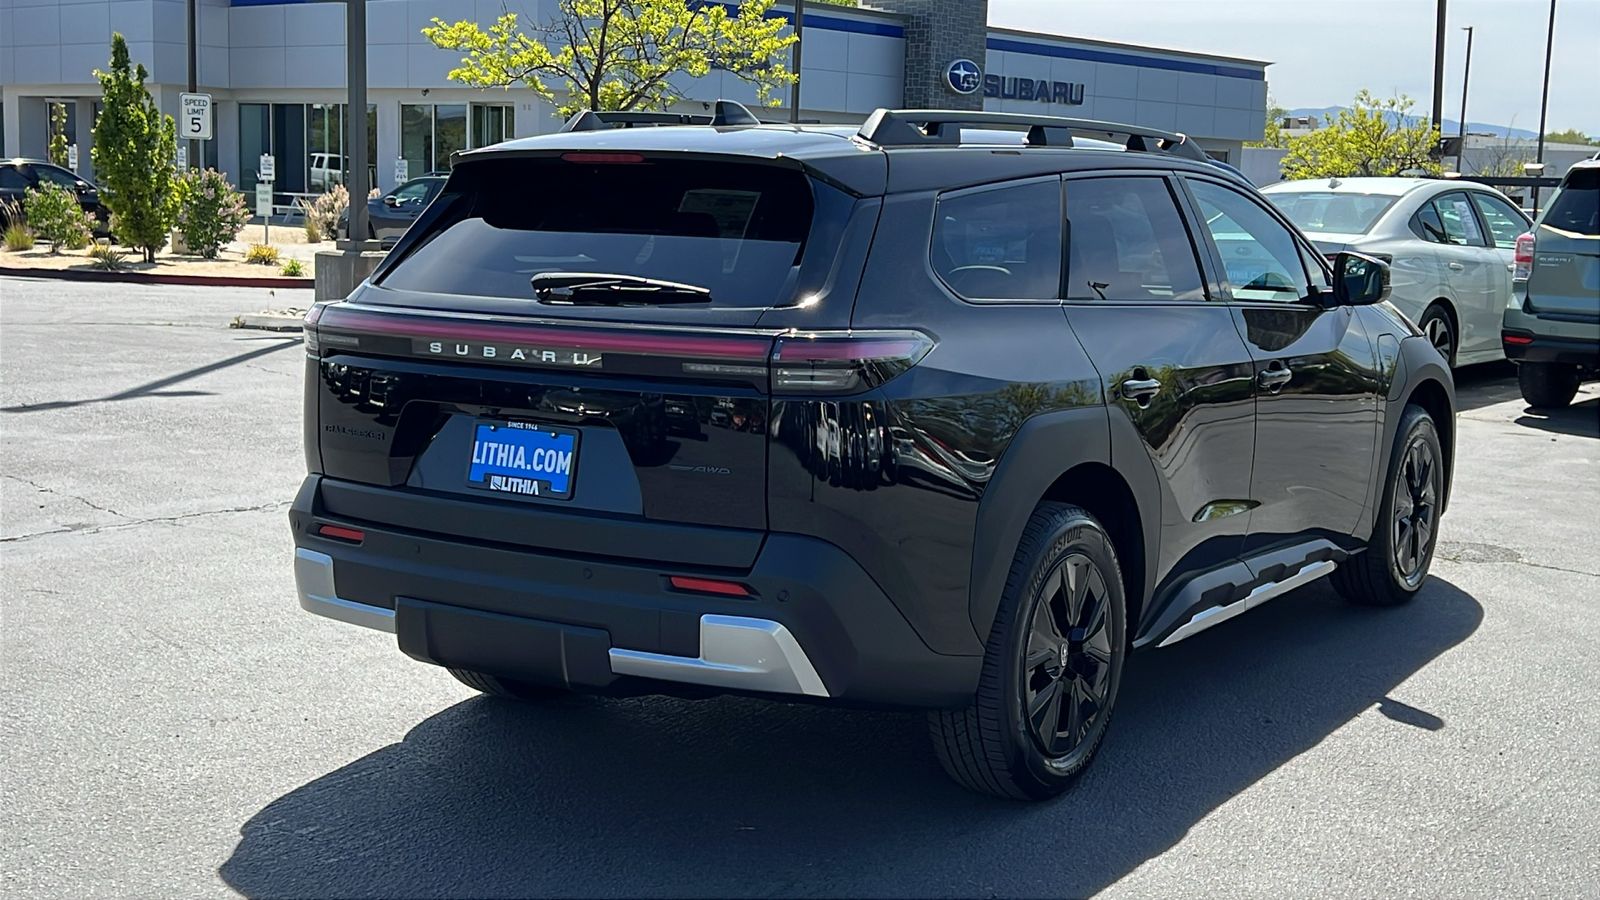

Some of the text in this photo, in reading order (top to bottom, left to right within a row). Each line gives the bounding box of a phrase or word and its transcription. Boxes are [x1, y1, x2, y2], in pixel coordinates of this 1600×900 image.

[984, 74, 1085, 106] SUBARU
[184, 98, 208, 107] SPEED
[190, 117, 202, 133] 5
[429, 342, 588, 365] SUBARU
[507, 421, 538, 431] SINCE 1946
[472, 440, 573, 476] LITHIA.COM
[692, 466, 731, 474] AWD
[500, 476, 539, 496] LITHIA
